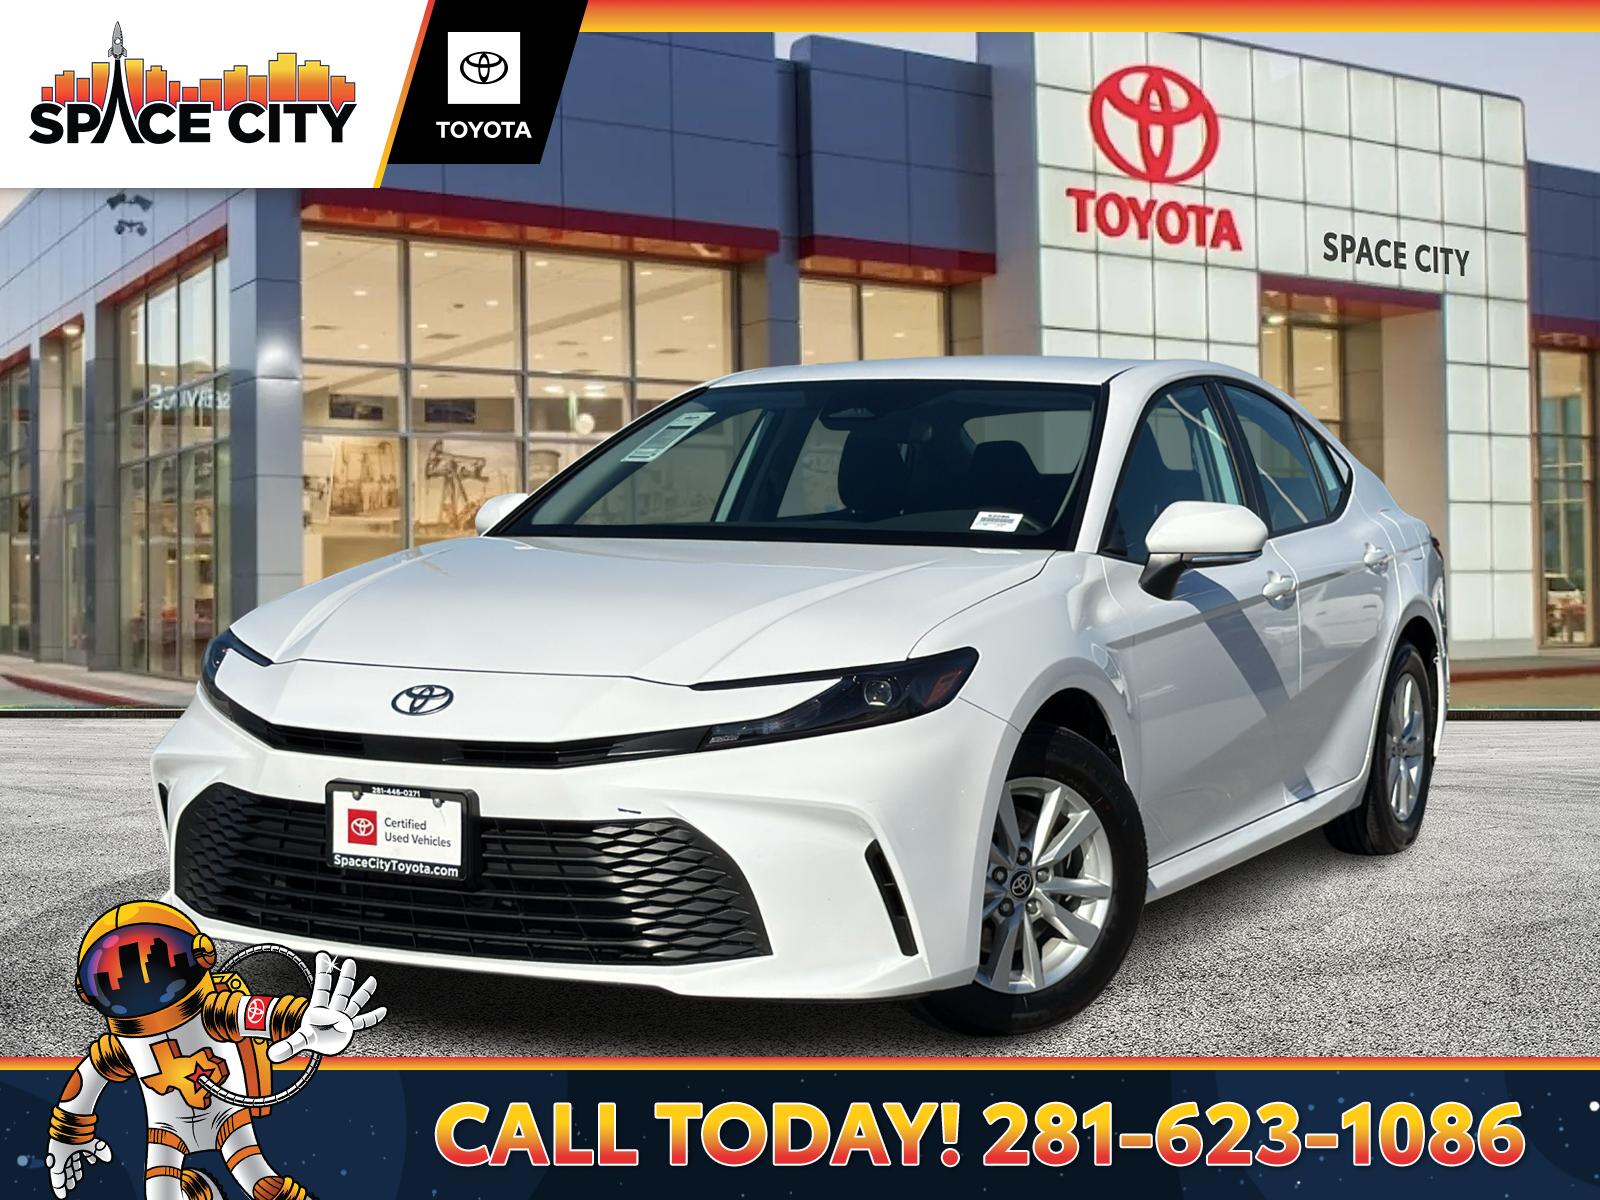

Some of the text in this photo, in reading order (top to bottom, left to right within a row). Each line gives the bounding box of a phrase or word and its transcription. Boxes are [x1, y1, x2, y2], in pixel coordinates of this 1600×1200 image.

[1067, 188, 1242, 251] TOYOTA
[1323, 232, 1470, 276] SPACE CITY
[385, 818, 427, 830] Certified
[385, 832, 451, 847] Used Vehicles
[333, 855, 459, 877] SpaceCityToyota.com
